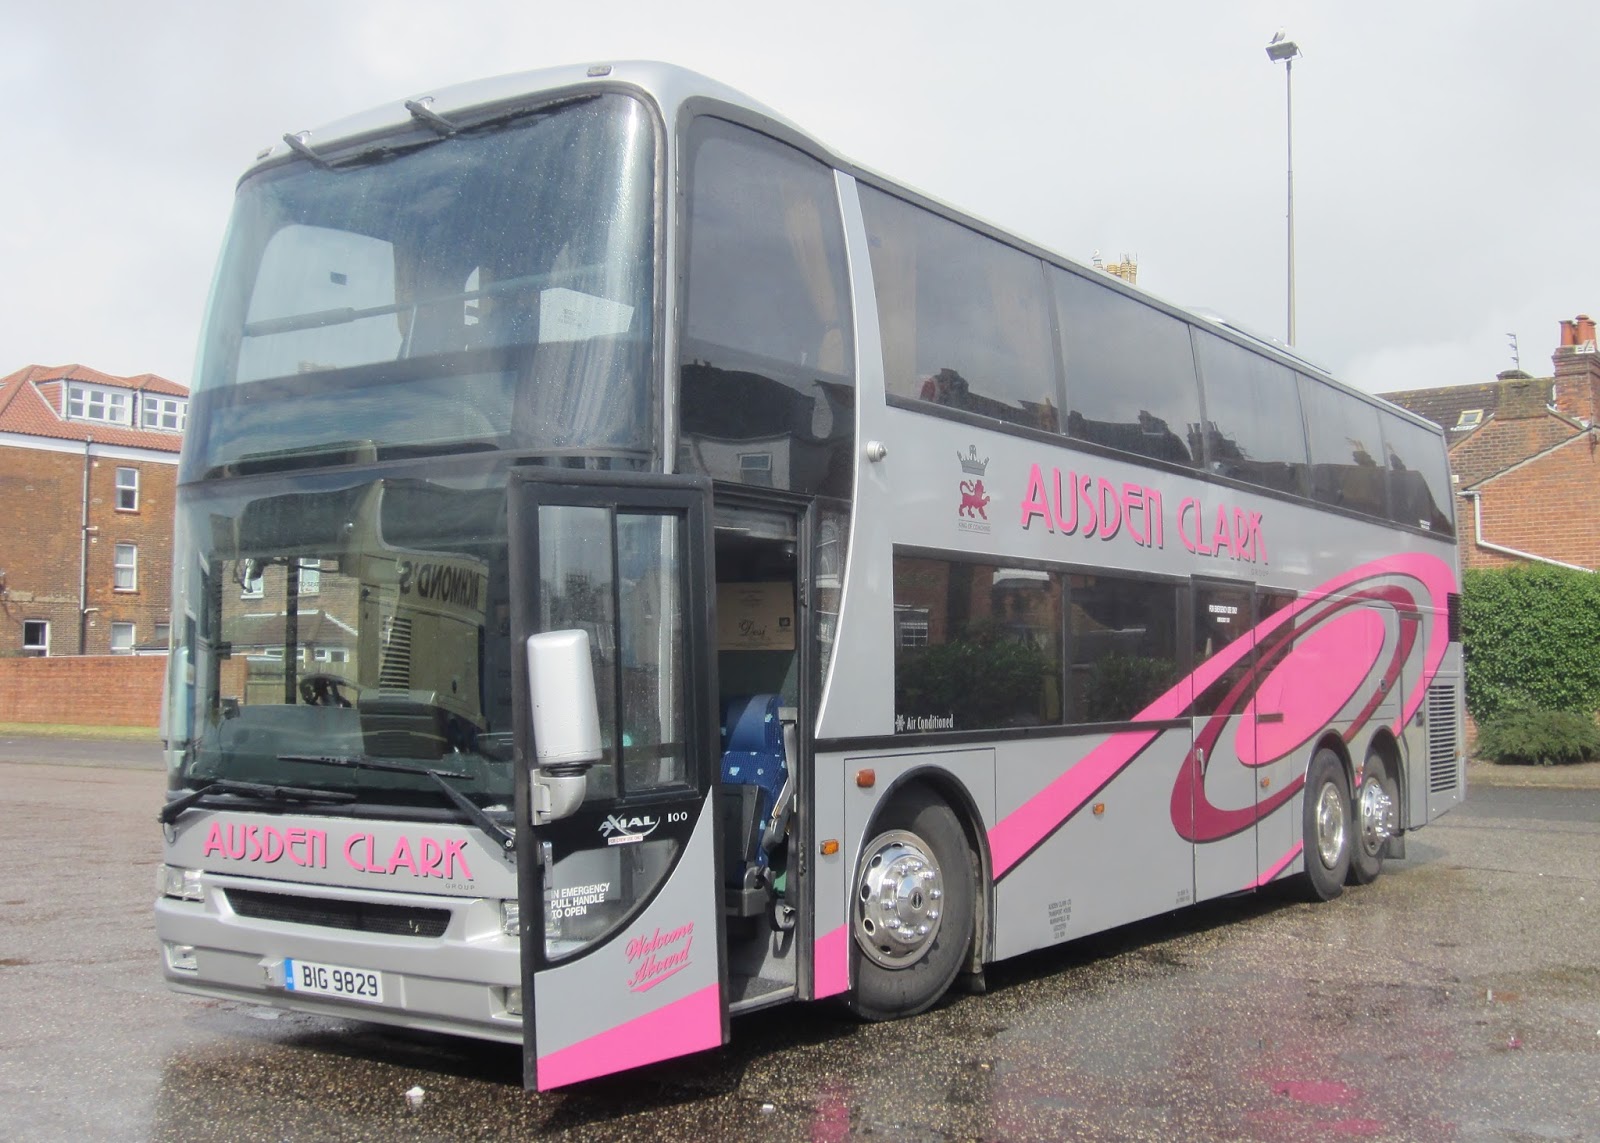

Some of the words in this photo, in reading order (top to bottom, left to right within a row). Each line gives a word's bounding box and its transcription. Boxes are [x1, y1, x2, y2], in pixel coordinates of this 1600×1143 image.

[1020, 463, 1163, 549] AUSDEN
[1176, 496, 1269, 565] CLARK
[907, 716, 916, 730] Air
[917, 713, 954, 730] Conditioned
[597, 812, 660, 838] AXIAL
[667, 811, 689, 823] 100
[203, 820, 327, 869] AUSDEN
[343, 833, 474, 881] CLARK
[551, 898, 571, 909] PULL
[572, 893, 605, 906] HANDLE
[561, 882, 610, 898] EMERGENCY
[551, 909, 563, 919] TO
[564, 905, 587, 917] OPEN
[625, 920, 694, 964] Welcome
[302, 965, 328, 989] BIG
[332, 970, 378, 997] 9829
